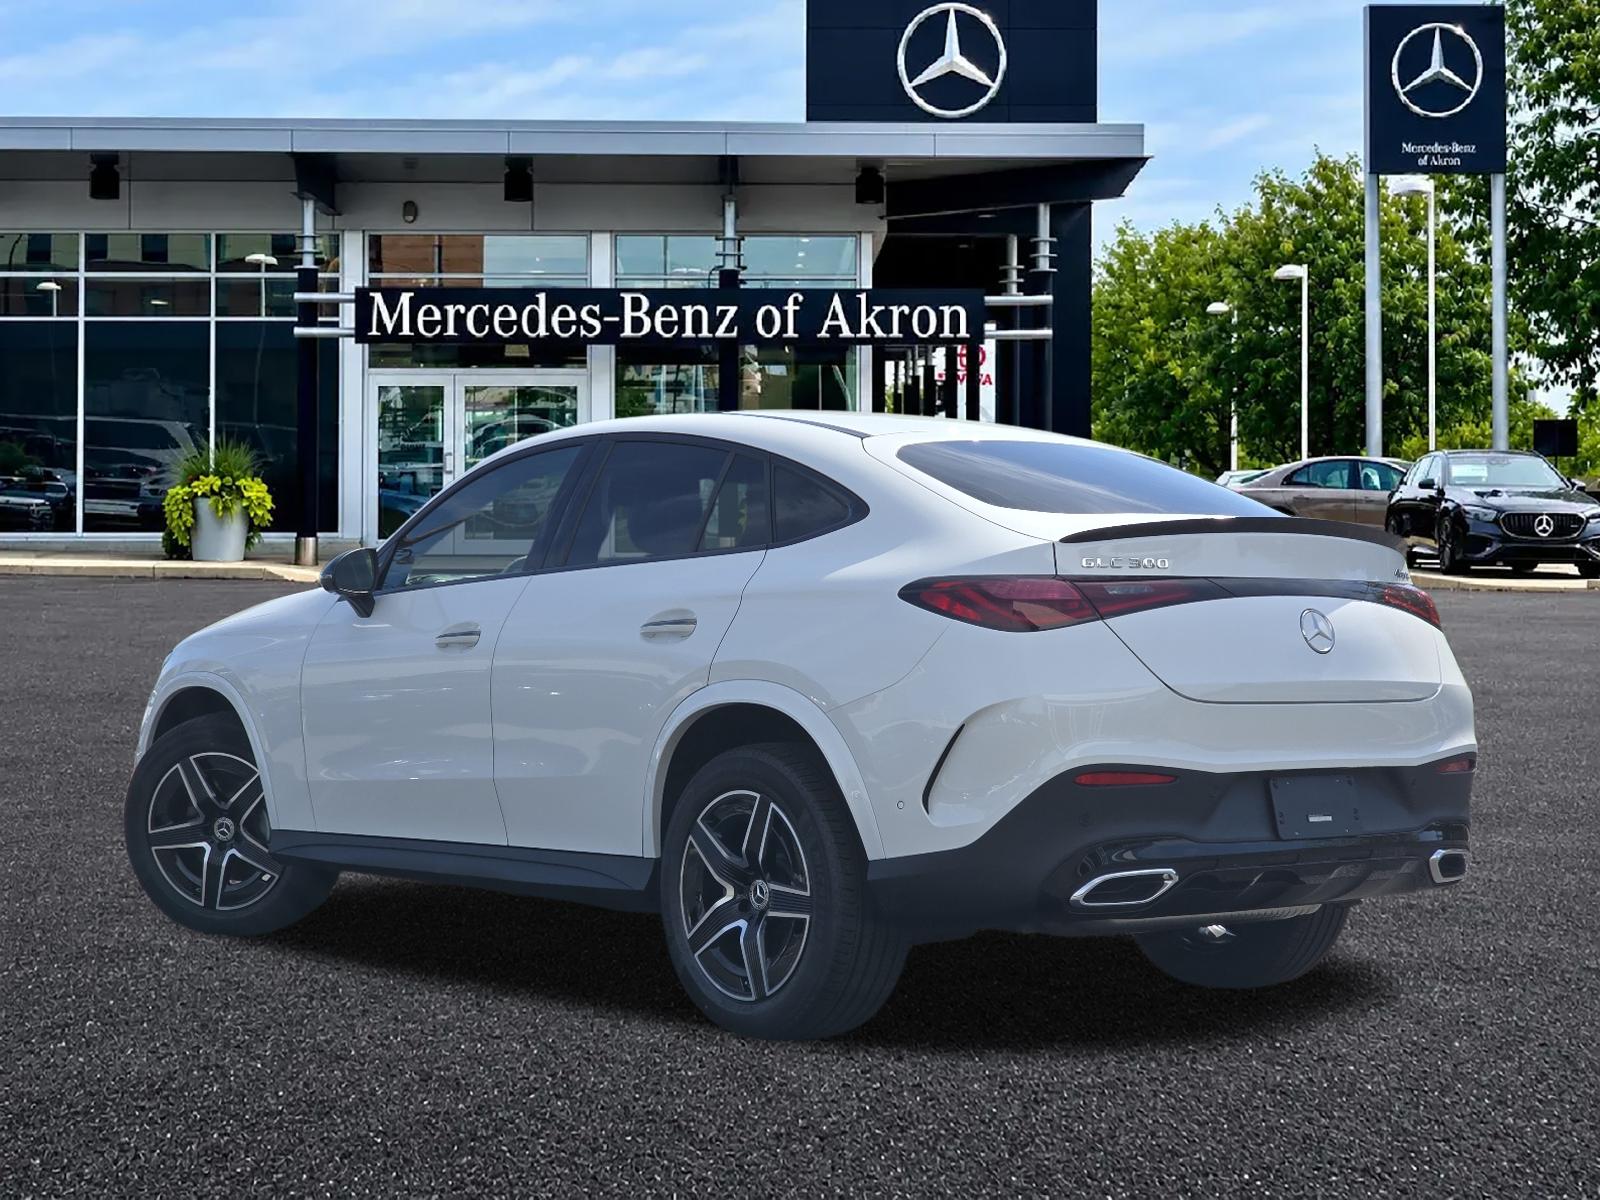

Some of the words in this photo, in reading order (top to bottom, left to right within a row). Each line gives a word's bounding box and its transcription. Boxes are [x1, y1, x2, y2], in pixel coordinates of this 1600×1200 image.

[1401, 142, 1477, 154] Mercedes-Benz
[1418, 154, 1428, 166] of
[1430, 155, 1461, 166] Akron
[367, 292, 738, 338] Mercedes-Benz
[755, 292, 804, 338] of
[816, 292, 970, 338] Akron
[1081, 557, 1123, 569] GLC
[1128, 557, 1169, 569] 300
